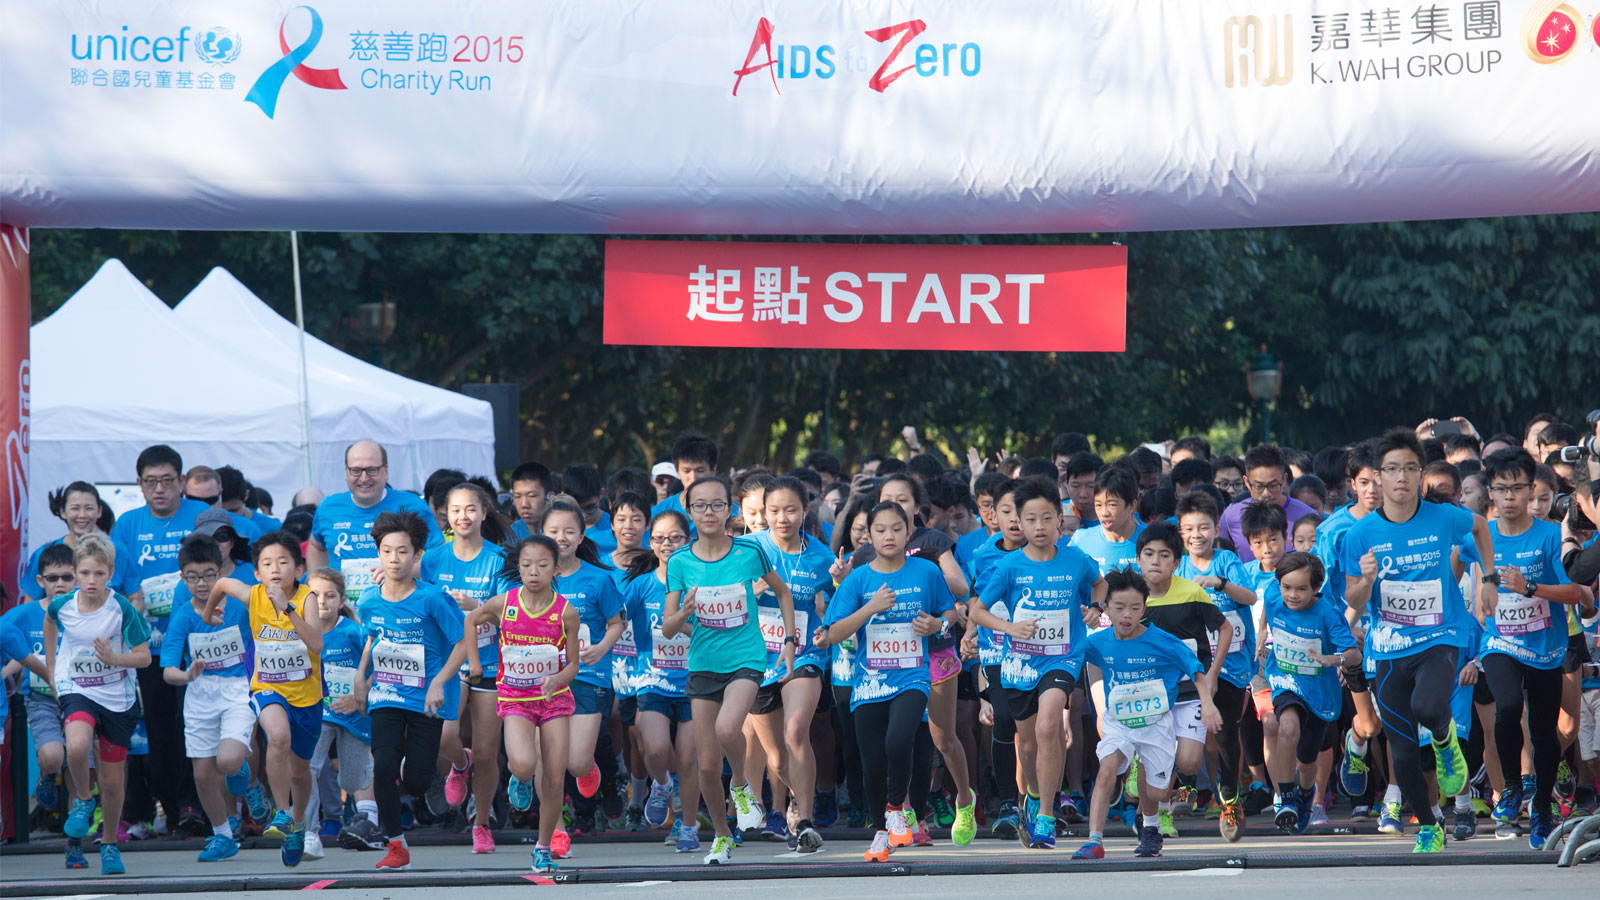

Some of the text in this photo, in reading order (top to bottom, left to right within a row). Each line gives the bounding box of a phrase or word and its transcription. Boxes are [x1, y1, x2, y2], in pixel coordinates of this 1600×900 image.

[1310, 0, 1502, 52] 嘉華集團
[71, 25, 192, 63] unicef
[732, 16, 836, 97] AIDS
[864, 18, 982, 93] Zero
[1338, 56, 1400, 82] WAH
[1406, 49, 1502, 78] GROUP
[70, 67, 237, 90] 聯合國兒童基金會
[360, 67, 492, 95] Charity Run
[686, 265, 1046, 326] 起點 START
[1402, 560, 1439, 571] Charity Run
[697, 600, 743, 615] K4014
[1387, 596, 1437, 611] K2027
[1498, 604, 1544, 621] K2021
[505, 631, 555, 645] Energetic
[194, 641, 239, 660] K1036
[872, 640, 918, 654] K3013
[74, 662, 118, 673] K104
[260, 655, 305, 670] K1045
[378, 656, 420, 672] K1028
[507, 660, 552, 675] K3001
[1114, 696, 1162, 716] F1673
